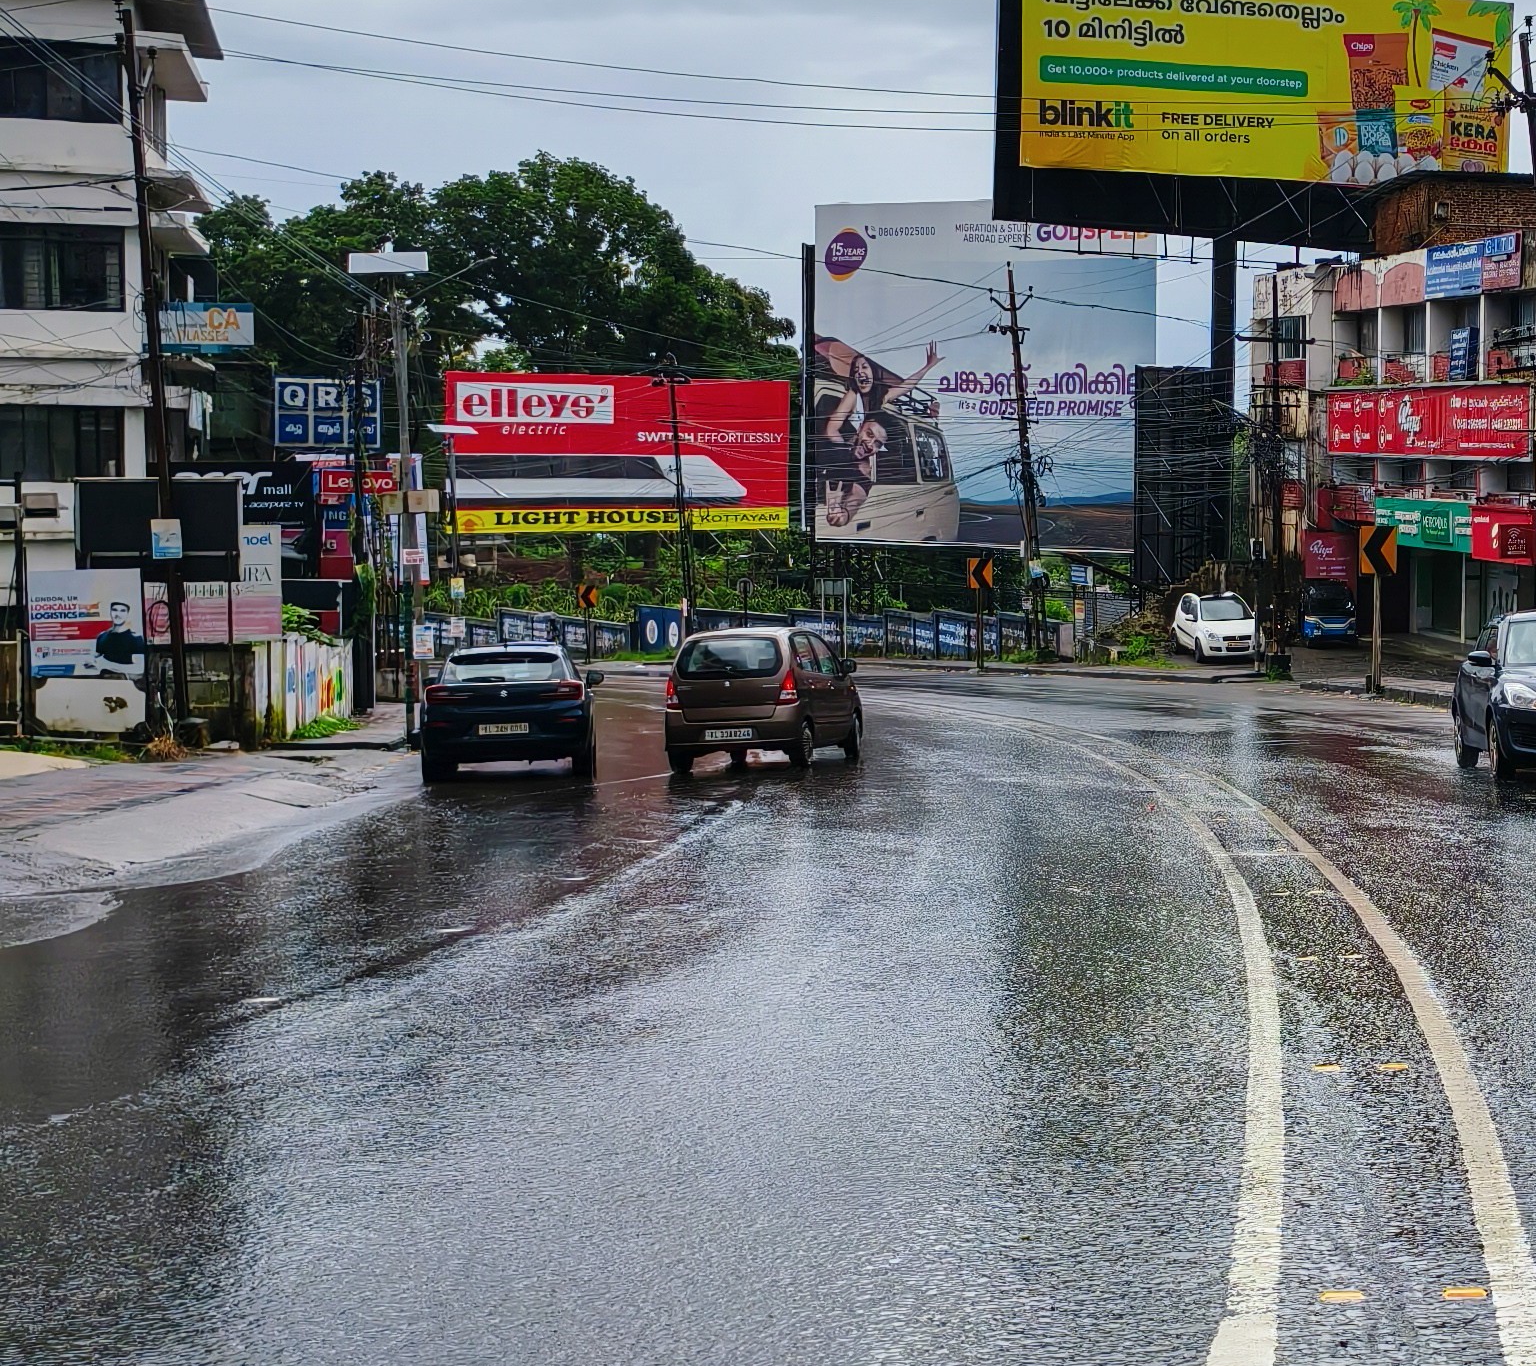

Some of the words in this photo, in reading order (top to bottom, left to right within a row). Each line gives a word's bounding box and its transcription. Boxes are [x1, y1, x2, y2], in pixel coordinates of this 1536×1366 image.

[1043, 19, 1070, 38] 10
[1047, 64, 1067, 75] Get
[1069, 65, 1114, 77] 10,000+
[1117, 67, 1164, 81] products
[1166, 70, 1215, 83] delivered
[1217, 74, 1228, 84] at
[1230, 75, 1254, 88] your
[1256, 76, 1303, 90] doorstep
[1039, 99, 1135, 128] blinkit
[1161, 111, 1199, 126] FREE
[1203, 113, 1275, 129] DELIVERY
[1117, 132, 1135, 142] App
[1161, 130, 1180, 140] on
[1184, 128, 1200, 142] all
[1204, 129, 1251, 144] orders
[955, 223, 998, 233] MIGRATION
[999, 223, 1005, 233] &
[1007, 223, 1032, 233] STUDY
[963, 233, 996, 243] ABROAD
[998, 233, 1032, 243] EXPERTS
[830, 242, 844, 256] 15
[843, 247, 866, 256] YEARS
[208, 307, 241, 331] CA
[979, 399, 1054, 416] GODSEED
[1056, 399, 1124, 417] PROMISE
[502, 423, 568, 435] electric
[697, 432, 784, 443] EFFORTLESSLY
[263, 483, 292, 495] mall
[494, 511, 581, 525] LIGHT
[586, 510, 678, 524] HOUSE
[700, 513, 780, 523] KOTTAYAM
[31, 611, 78, 620] LOGISTICS
